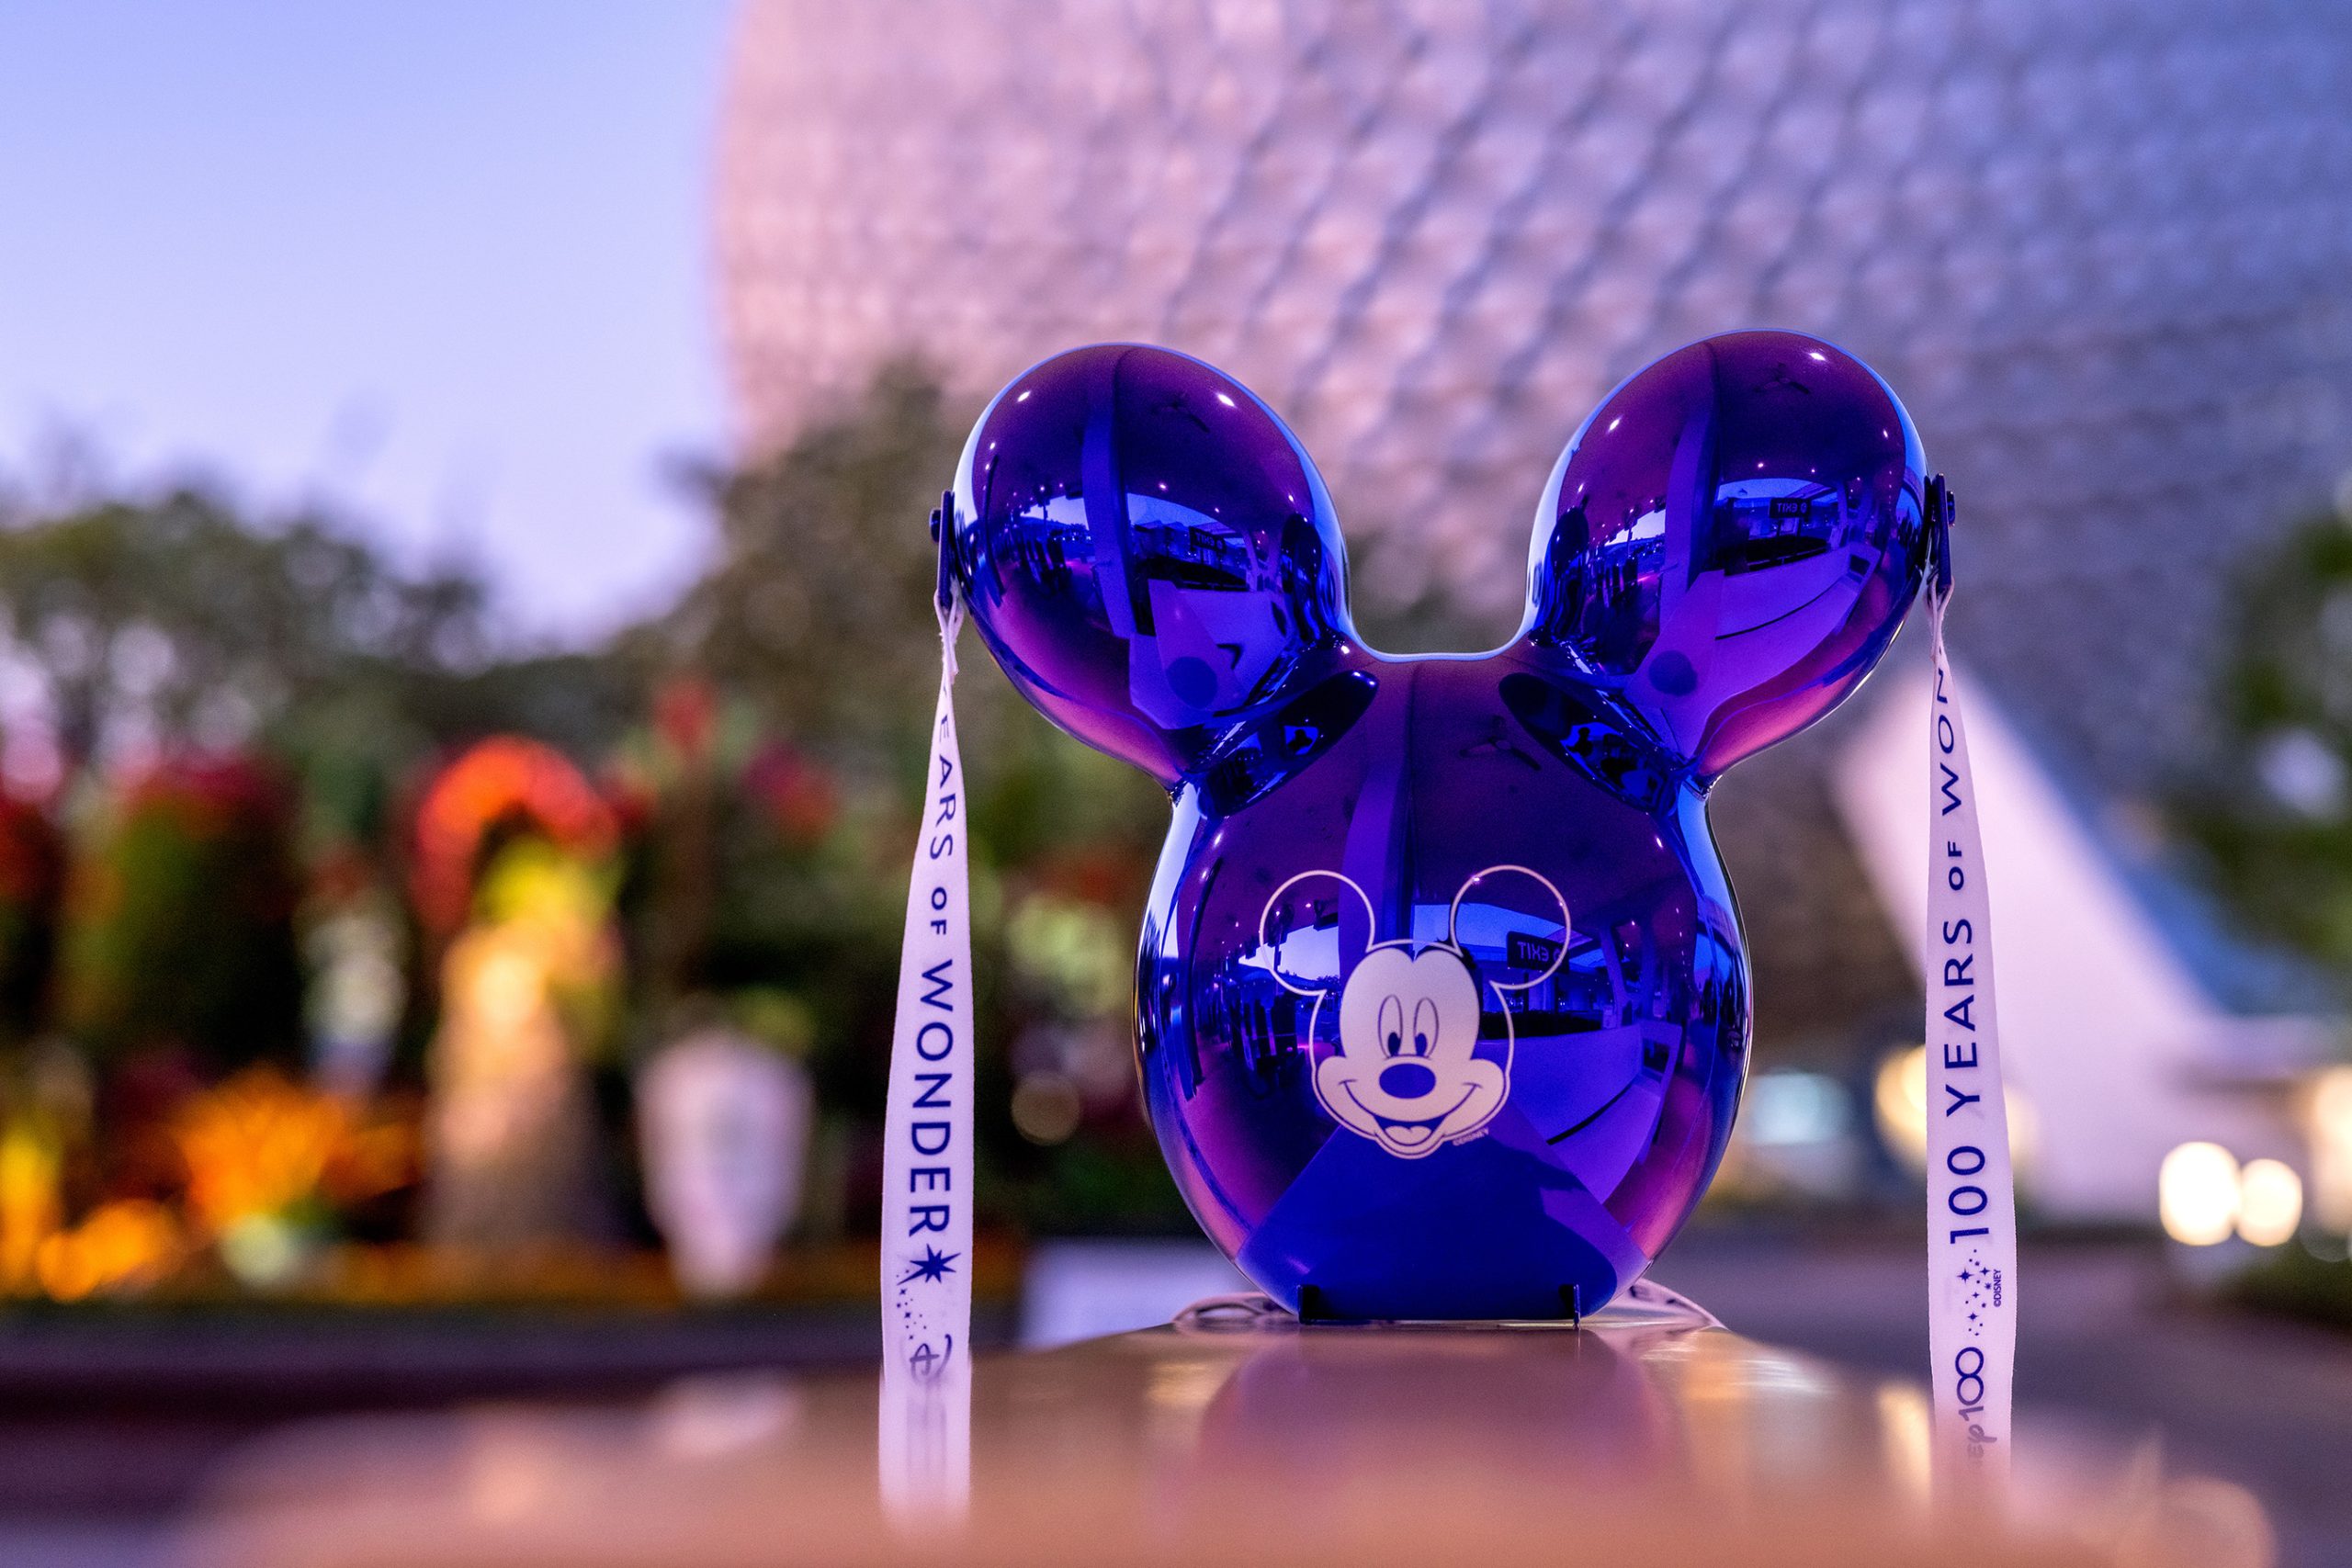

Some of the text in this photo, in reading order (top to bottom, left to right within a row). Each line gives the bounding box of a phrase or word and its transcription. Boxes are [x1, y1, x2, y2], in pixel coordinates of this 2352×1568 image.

[909, 687, 956, 1237] EARS OF WONDER
[1936, 646, 1990, 1245] 100 YEARS OF WON
